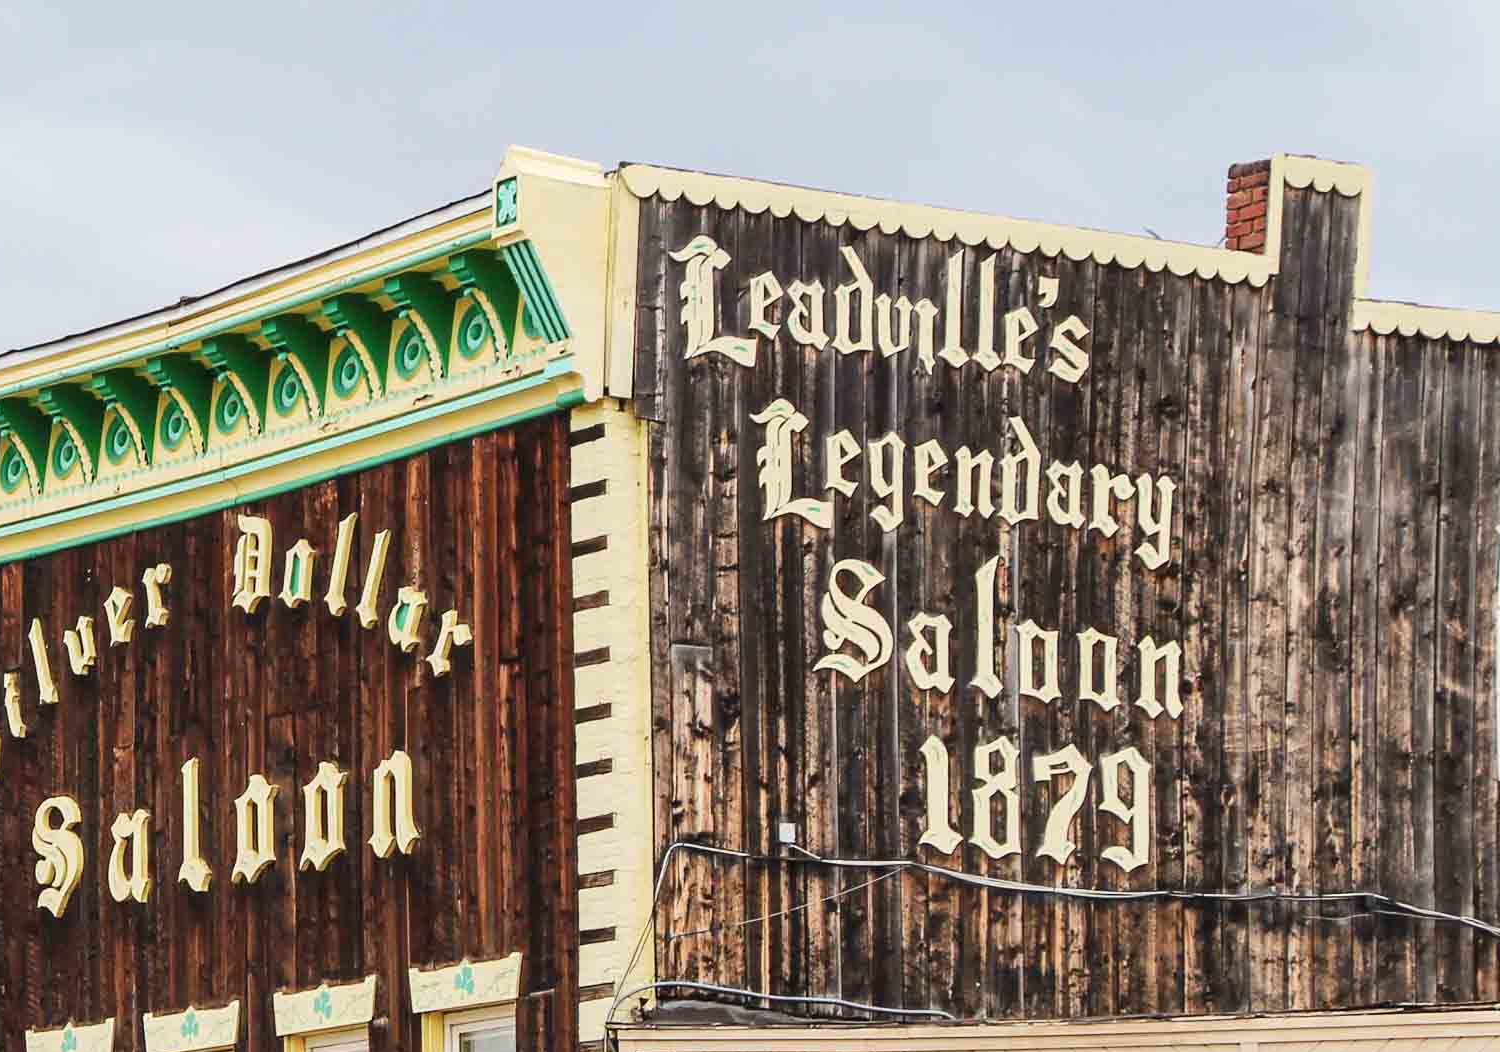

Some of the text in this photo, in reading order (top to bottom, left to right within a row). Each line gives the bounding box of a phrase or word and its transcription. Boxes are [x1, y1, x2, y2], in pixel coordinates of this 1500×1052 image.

[668, 234, 1092, 384] Leadville's
[750, 397, 1178, 571] Legendary
[231, 511, 474, 678] Dollar
[813, 556, 1185, 722] Saloon
[31, 750, 422, 919] Saloon
[917, 735, 1153, 873] 1879
